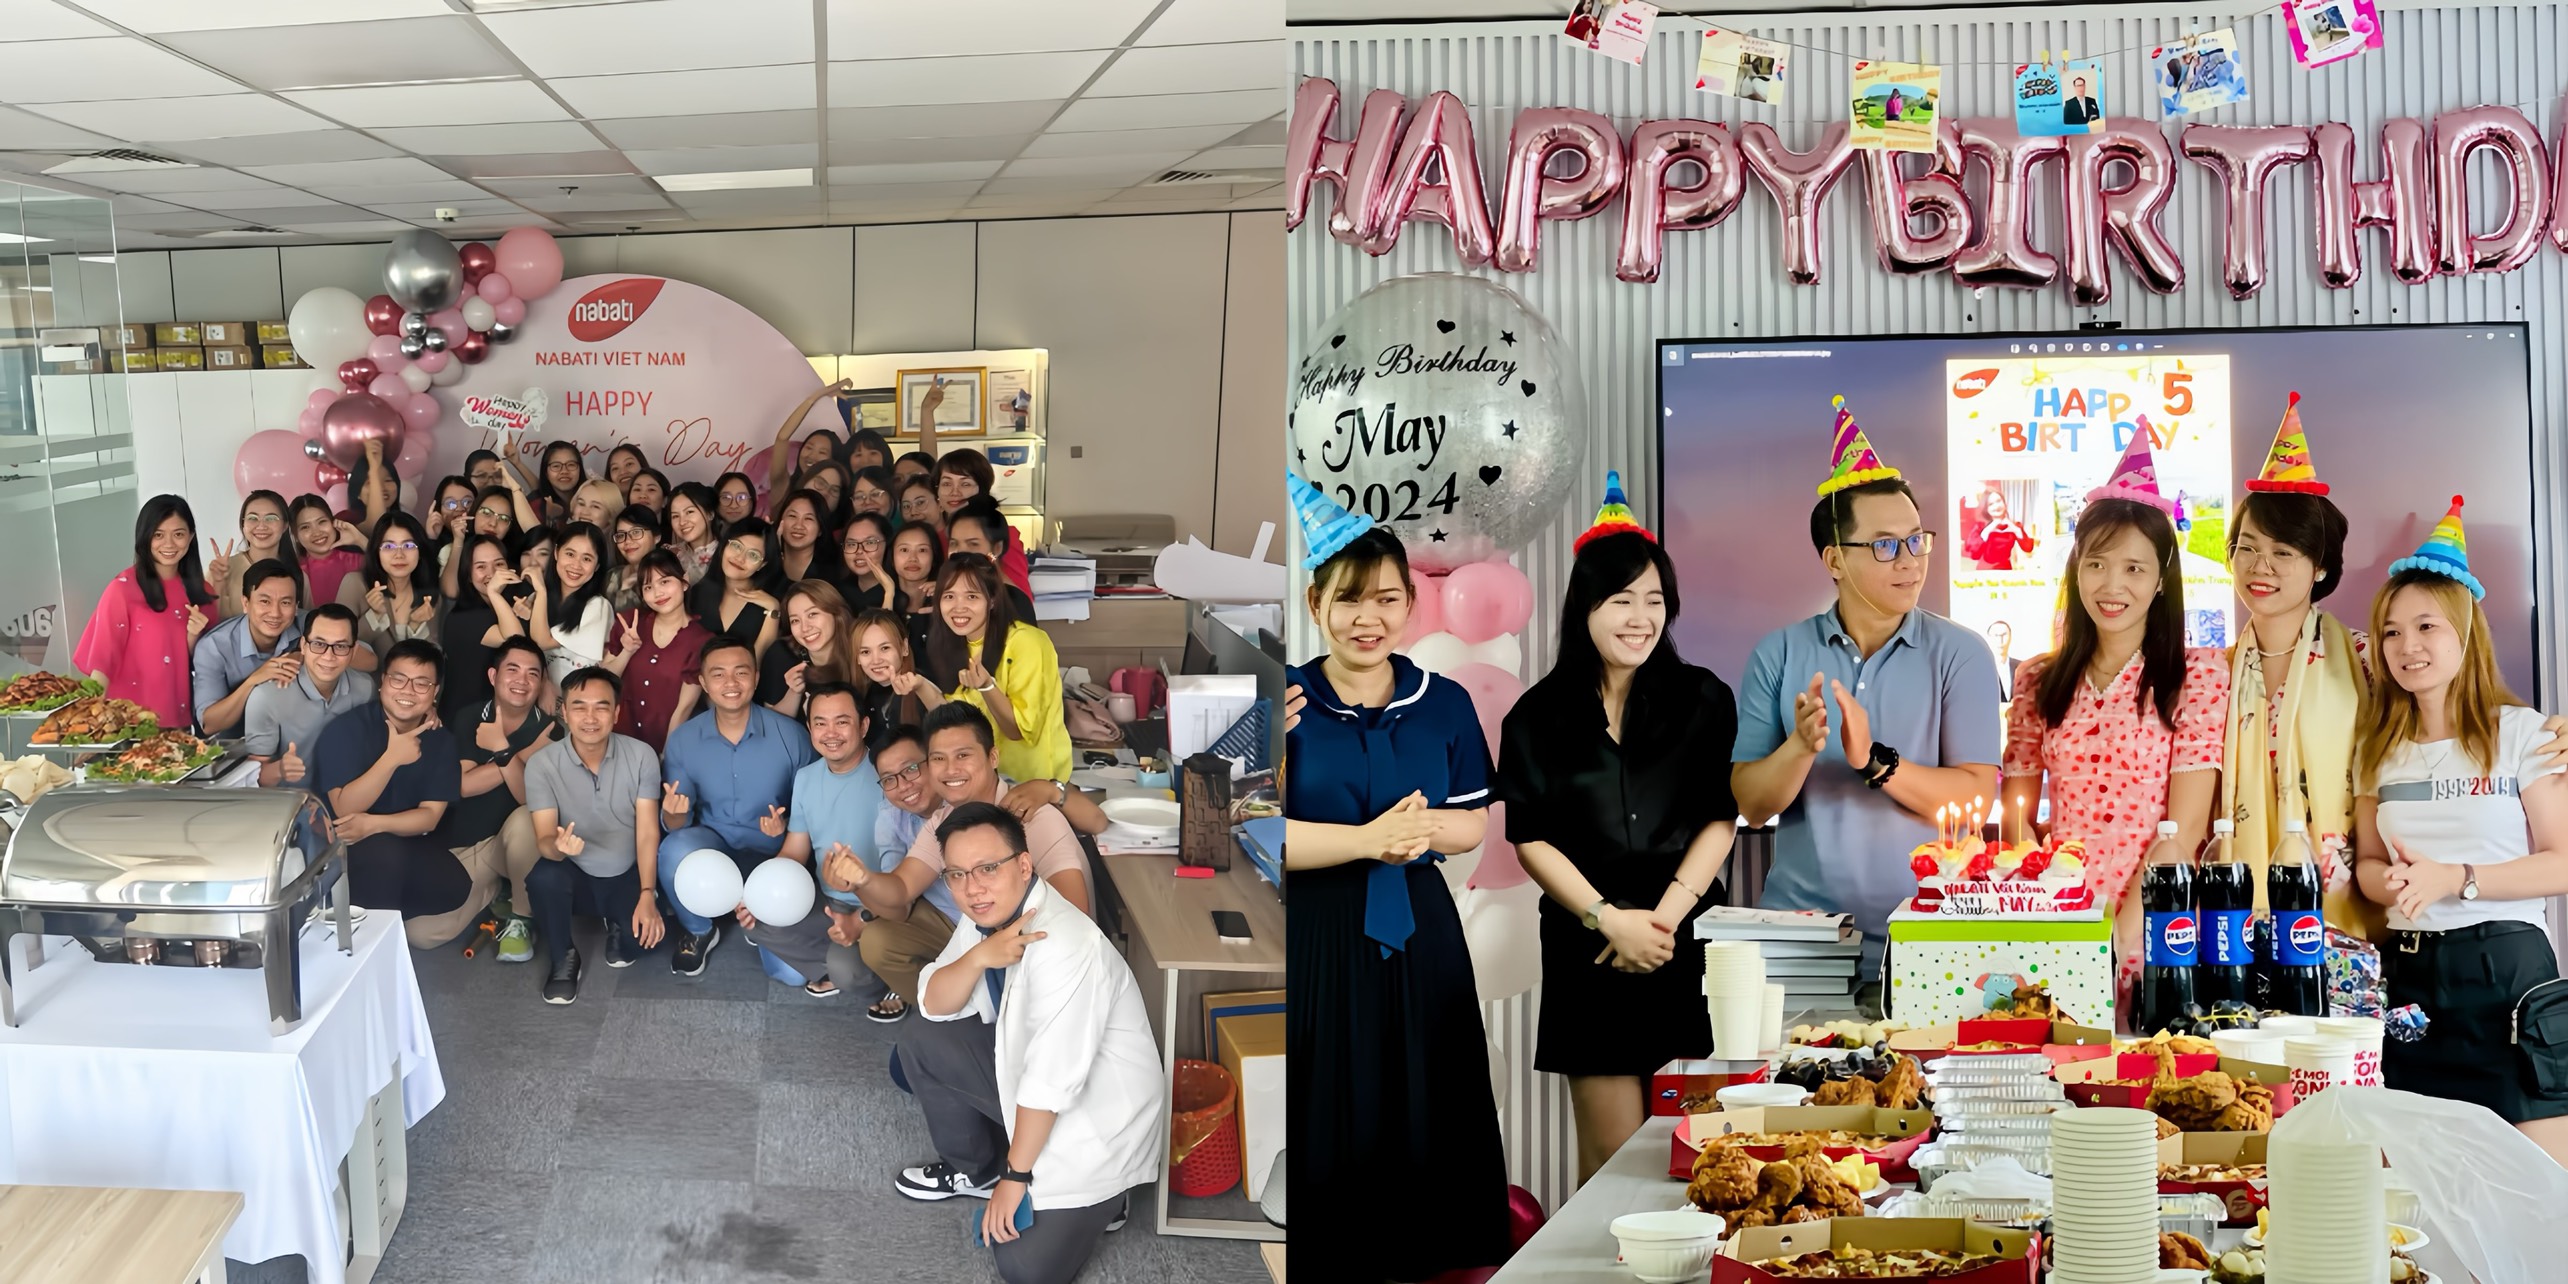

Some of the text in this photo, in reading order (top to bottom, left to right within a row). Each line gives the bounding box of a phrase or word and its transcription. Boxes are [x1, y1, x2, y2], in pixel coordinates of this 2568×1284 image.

[1286, 76, 2568, 307] HAPPY BIRTHD
[575, 298, 633, 322] nabati
[535, 351, 686, 366] NABATI VIET NAM
[1294, 343, 1518, 410] Happy Birthday
[566, 390, 653, 416] HAPPY
[2163, 372, 2194, 416] 5
[664, 417, 752, 473] Day
[1323, 402, 1446, 472] May
[1336, 472, 1461, 523] 2024
[2217, 915, 2230, 961] PEPSI
